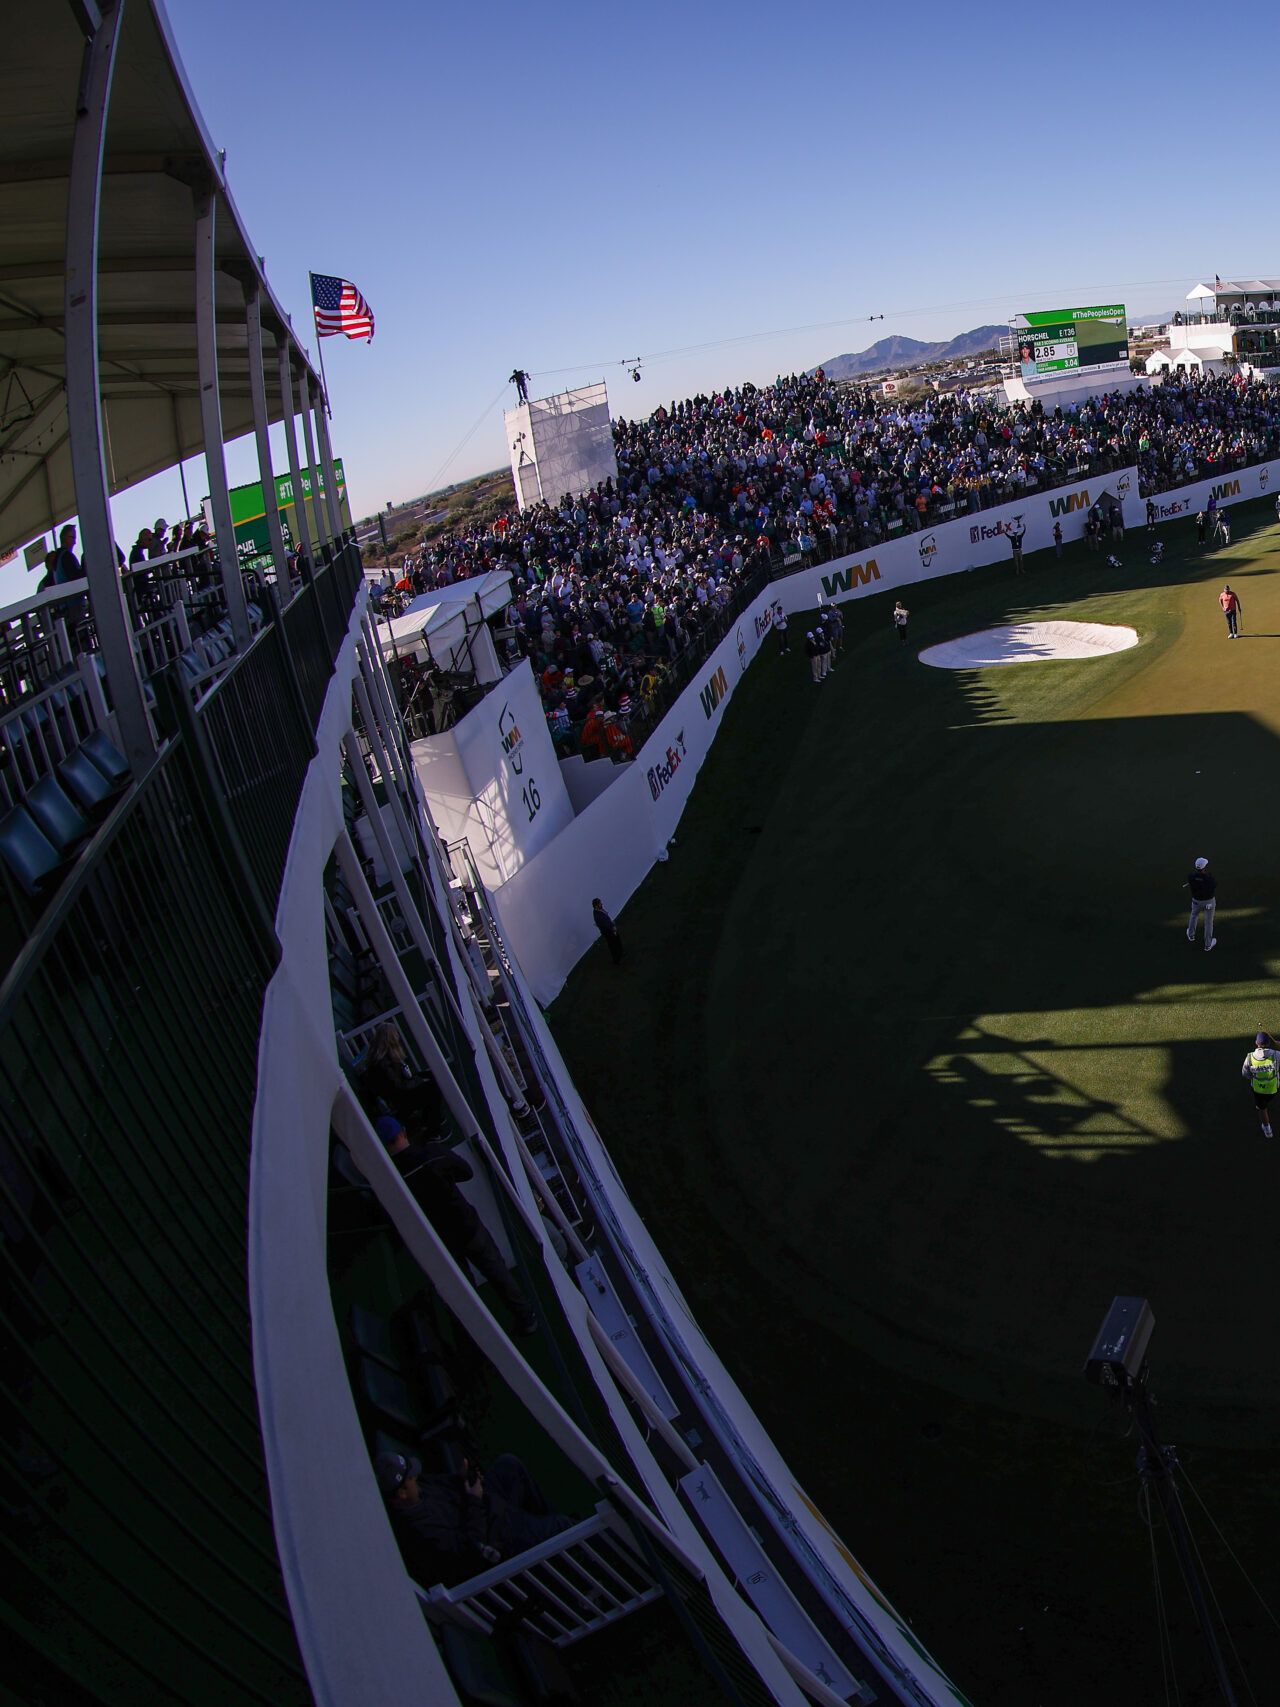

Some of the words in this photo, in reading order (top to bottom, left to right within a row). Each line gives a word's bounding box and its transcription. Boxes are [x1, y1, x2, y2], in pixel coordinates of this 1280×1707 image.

[1072, 309, 1125, 319] #ThePeoplesOpen
[1018, 332, 1049, 343] HORSCHEL
[1036, 346, 1055, 358] 2.85
[1065, 359, 1077, 368] 3.04
[1211, 479, 1241, 500] WM
[1049, 490, 1091, 518] WM
[1160, 501, 1183, 519] FedEx
[980, 520, 1013, 540] FedEx
[918, 545, 937, 556] WM
[820, 559, 881, 597] WM
[700, 665, 728, 720] WM
[501, 725, 521, 754] WM
[656, 746, 682, 791] FedEx
[522, 777, 541, 823] 16
